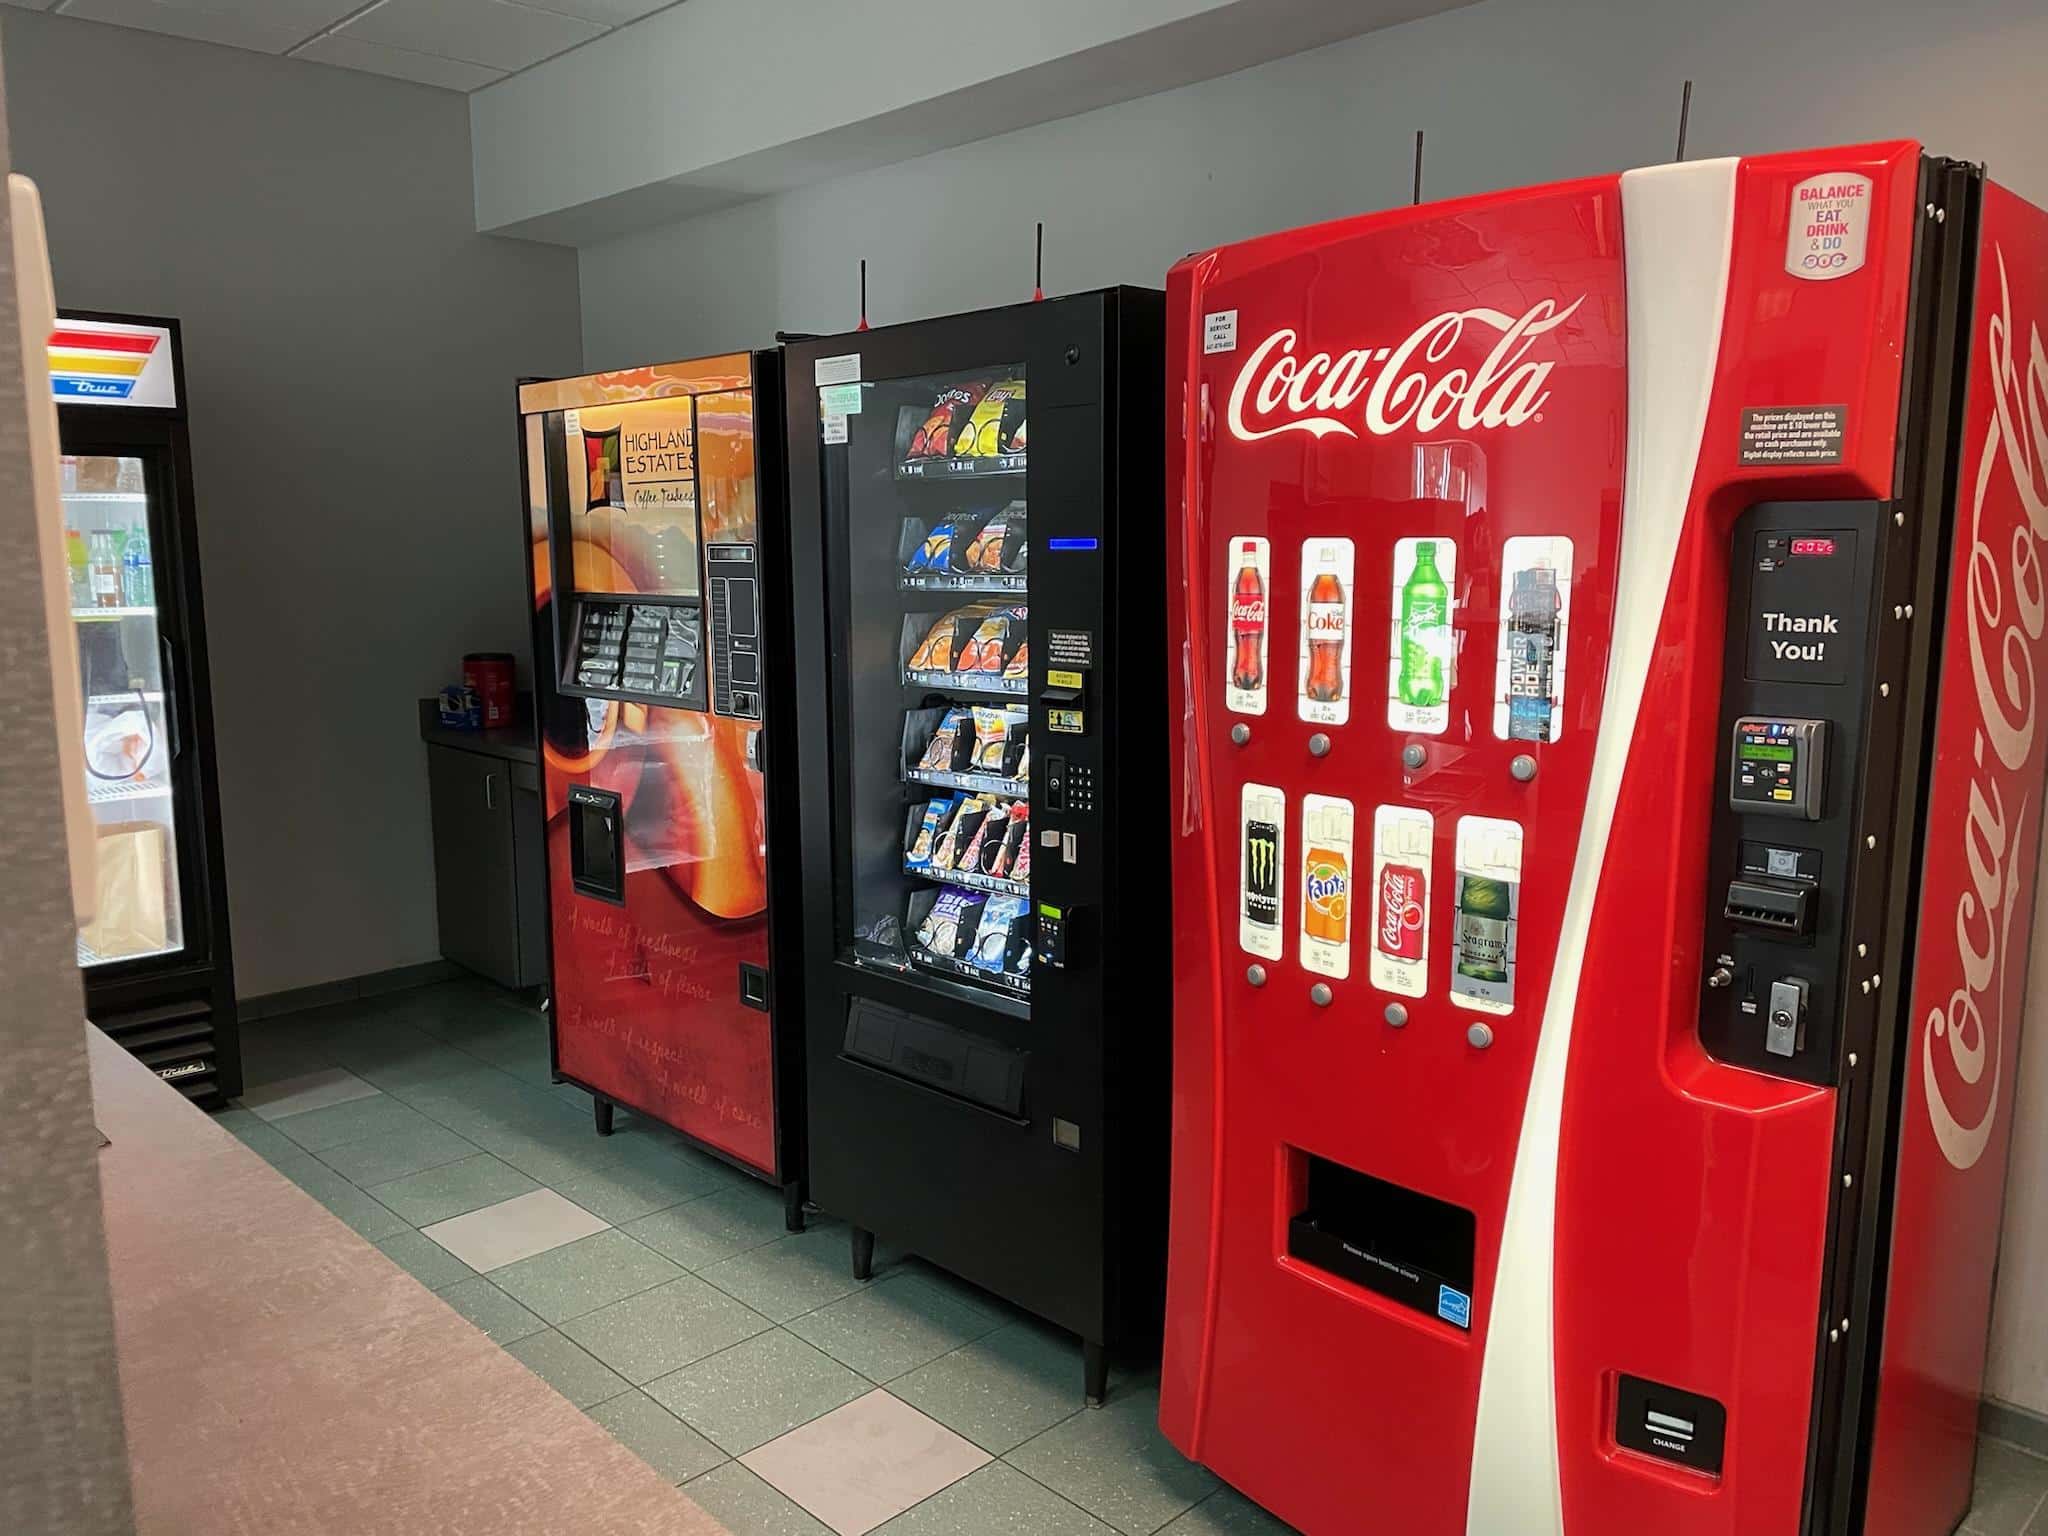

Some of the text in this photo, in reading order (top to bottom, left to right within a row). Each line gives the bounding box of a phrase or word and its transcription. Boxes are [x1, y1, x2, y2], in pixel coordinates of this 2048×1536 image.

[1800, 184, 1864, 201] BALANCE
[1808, 199, 1854, 210] WHAT YOU
[1807, 223, 1848, 237] DRINK
[1811, 237, 1841, 250] & DO
[1228, 293, 1587, 441] Coca-Cola
[70, 380, 121, 393] True
[625, 428, 693, 452] HIGHLAND
[626, 452, 695, 473] ESTATES
[634, 489, 657, 509] Coffee
[1232, 600, 1264, 622] Coca-Cola
[1308, 611, 1344, 631] Coke
[1763, 613, 1839, 633] Thank
[1771, 640, 1824, 661] You!
[1512, 638, 1528, 695] POWER
[1526, 664, 1539, 696] ADE
[1652, 1438, 1686, 1452] CHANGE
